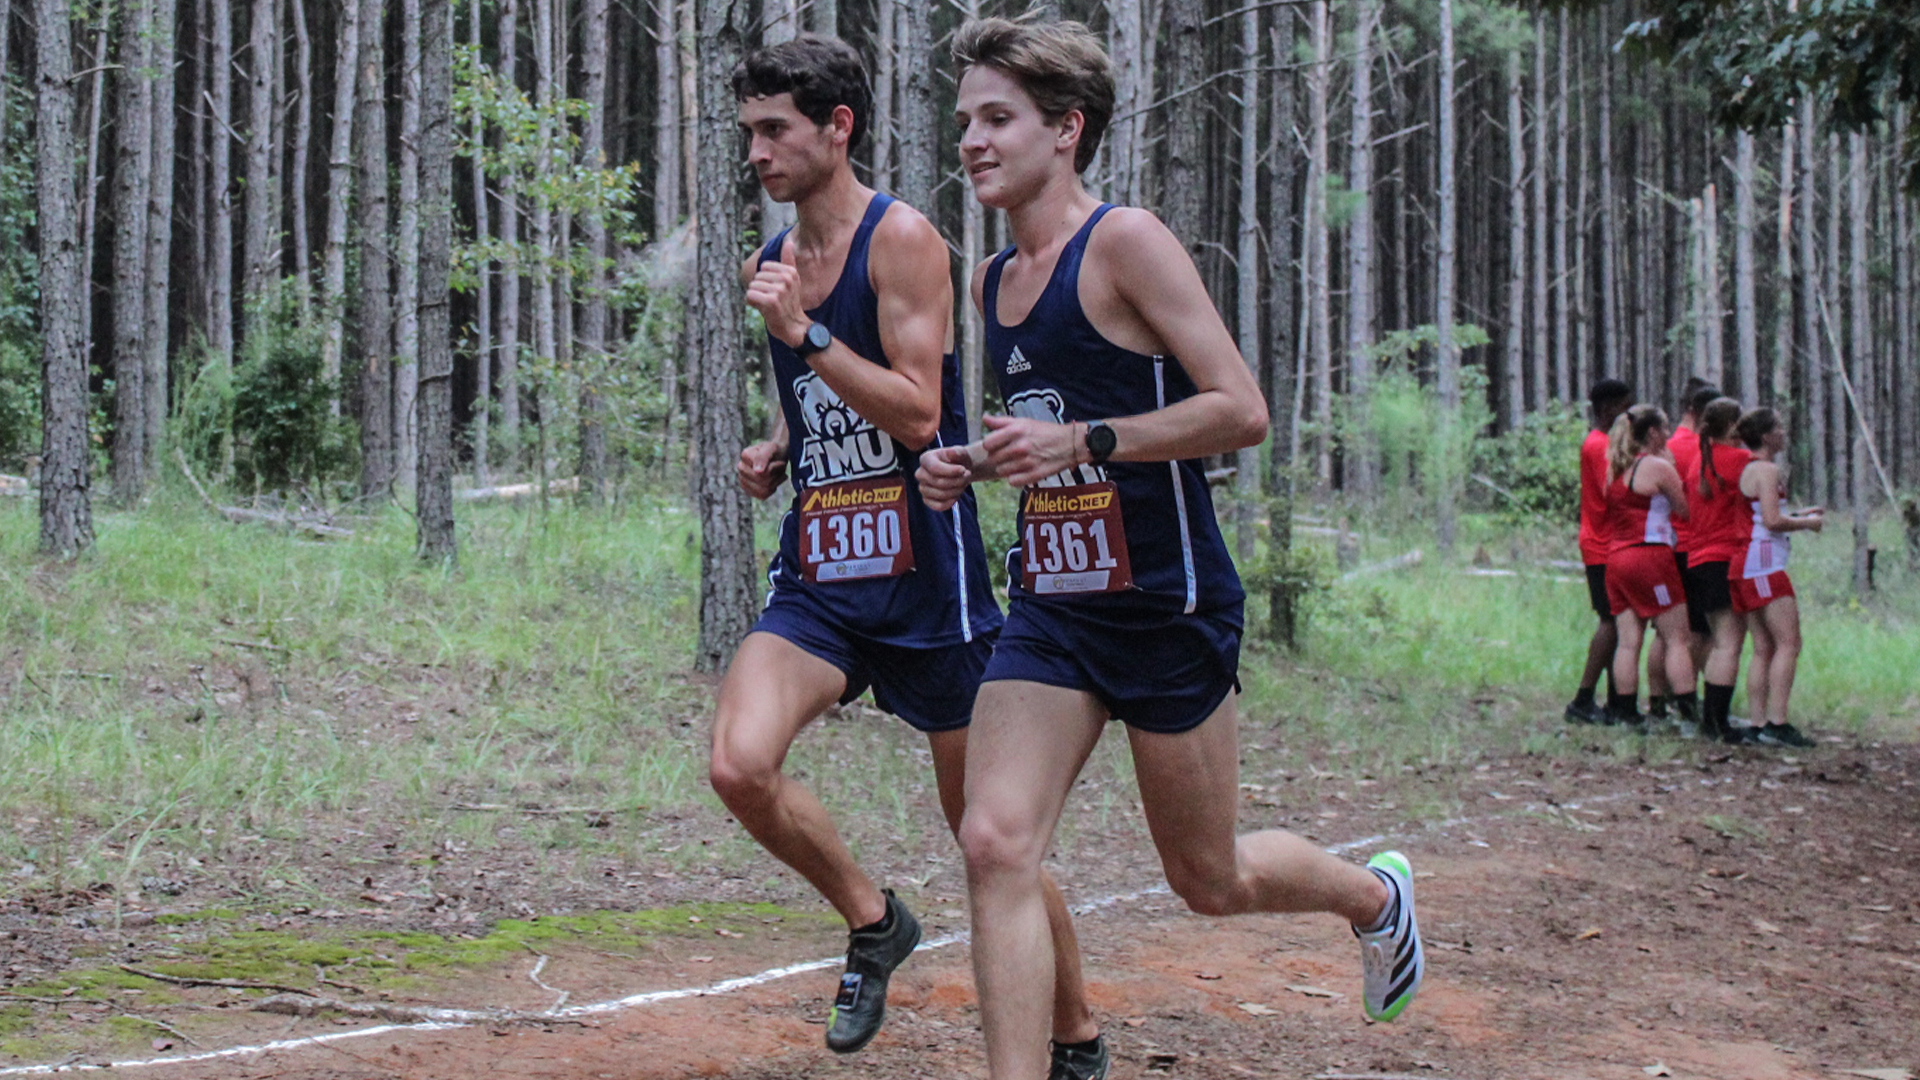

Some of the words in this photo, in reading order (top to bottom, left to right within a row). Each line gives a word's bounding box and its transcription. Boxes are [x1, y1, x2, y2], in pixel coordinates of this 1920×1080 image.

[1006, 355, 1032, 375] adidas
[803, 430, 895, 480] TMU
[806, 509, 901, 564] 1360
[1025, 519, 1117, 573] 1361
